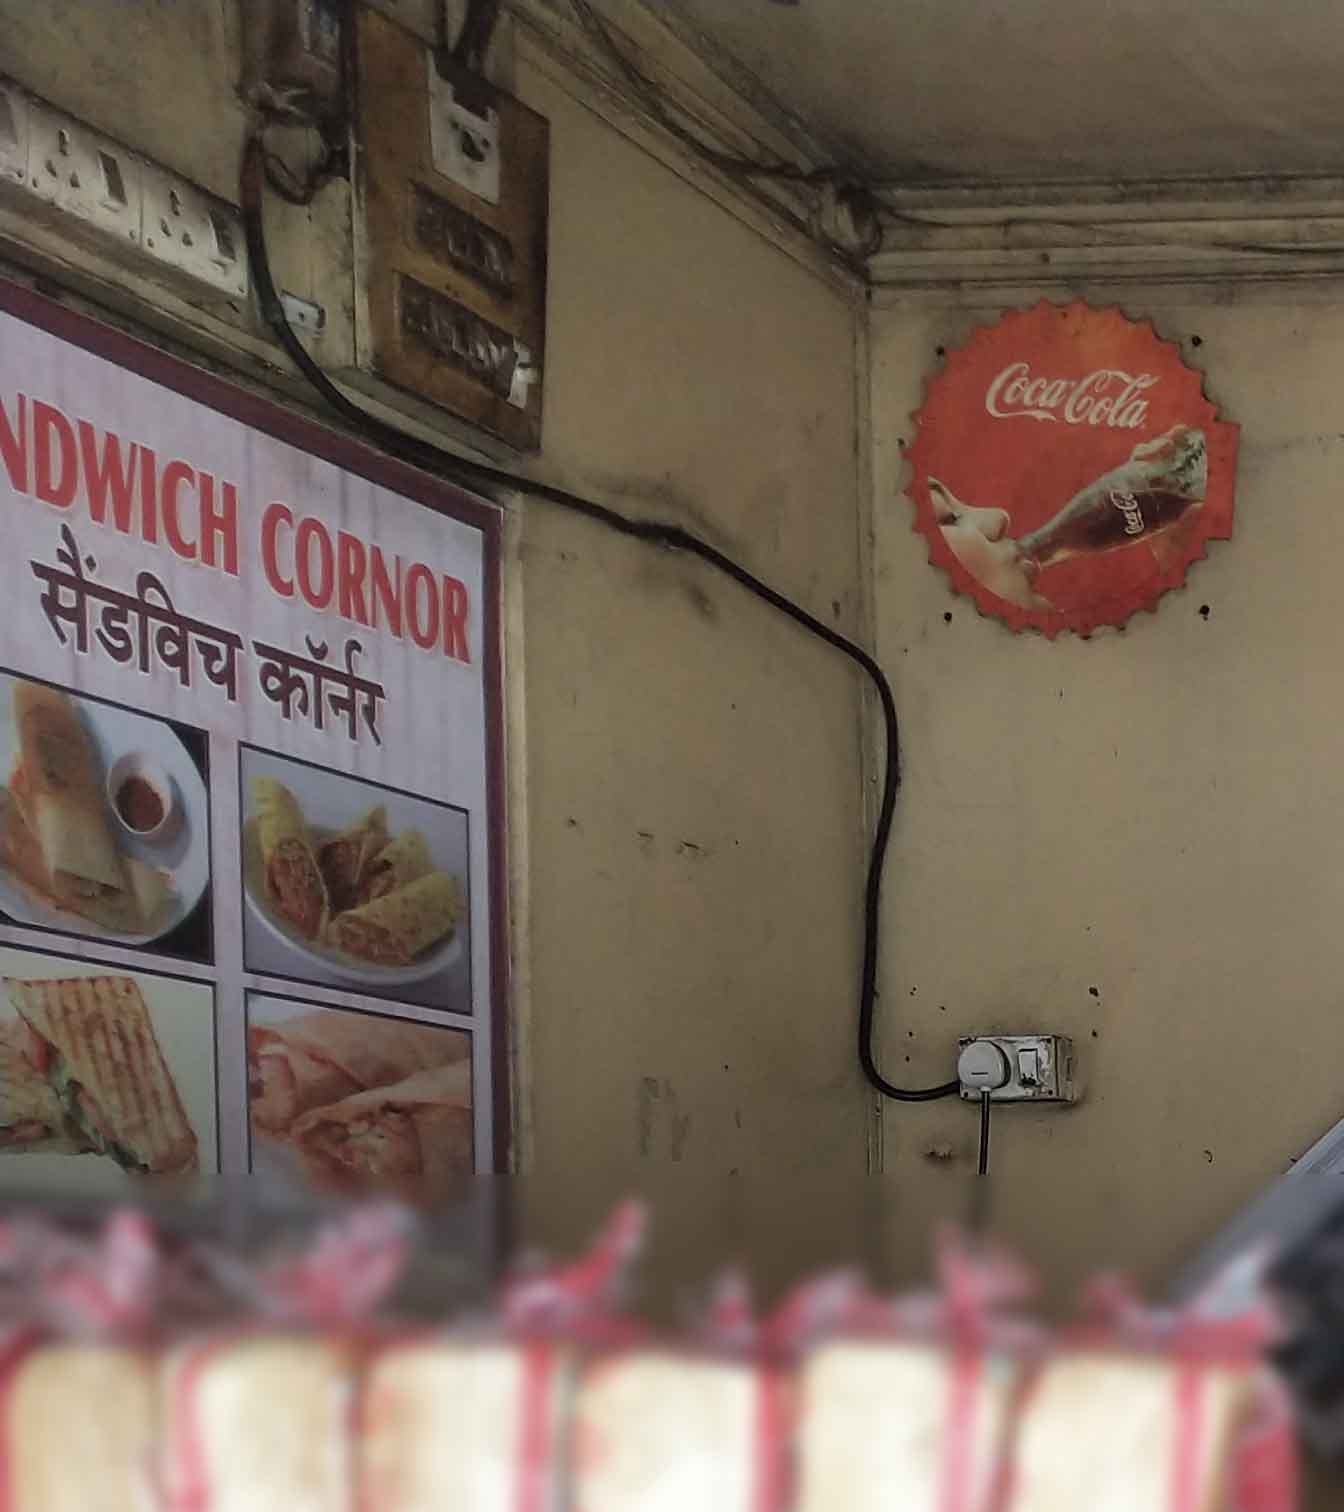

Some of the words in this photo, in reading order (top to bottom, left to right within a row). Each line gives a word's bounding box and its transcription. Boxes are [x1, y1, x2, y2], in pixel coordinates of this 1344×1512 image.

[30, 523, 244, 701] सैंडविच
[252, 634, 386, 745] कॉर्नर
[260, 503, 471, 664] CORNOR
